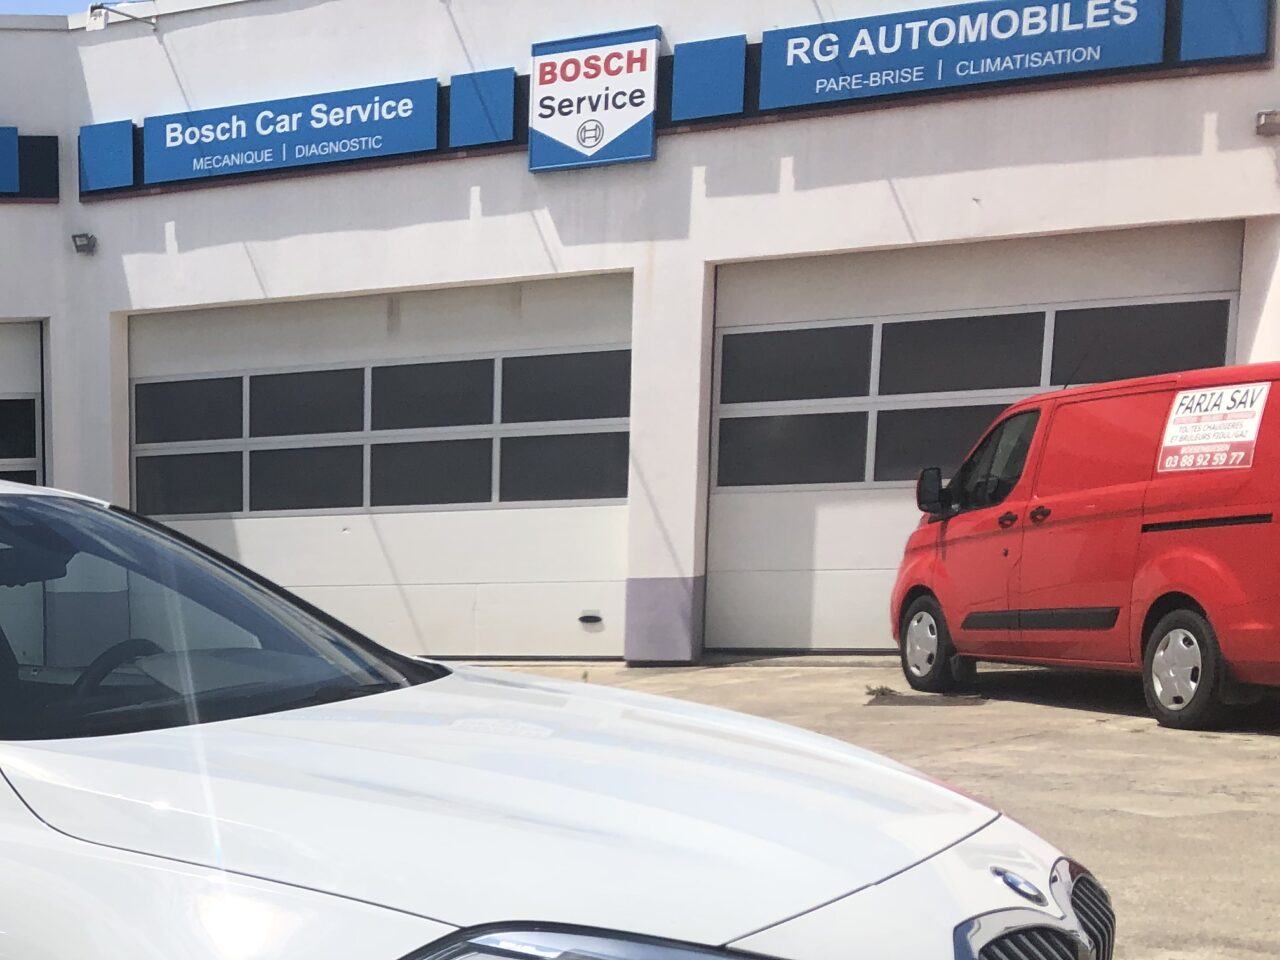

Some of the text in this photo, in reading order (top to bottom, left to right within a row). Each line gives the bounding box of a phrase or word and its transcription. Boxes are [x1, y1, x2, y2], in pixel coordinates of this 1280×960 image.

[786, 0, 1138, 66] RG AUTOMOBILES
[538, 47, 648, 85] BOSCH
[815, 45, 1101, 93] PARE-BRISE CLIMATISATION
[538, 86, 646, 119] Service
[165, 96, 414, 148] Bosch Car Service
[192, 135, 383, 171] MECANIQUE DIAGNOSTIC
[1175, 387, 1265, 416] FARIA SAV
[1165, 451, 1246, 468] 03 88 92 59 77
